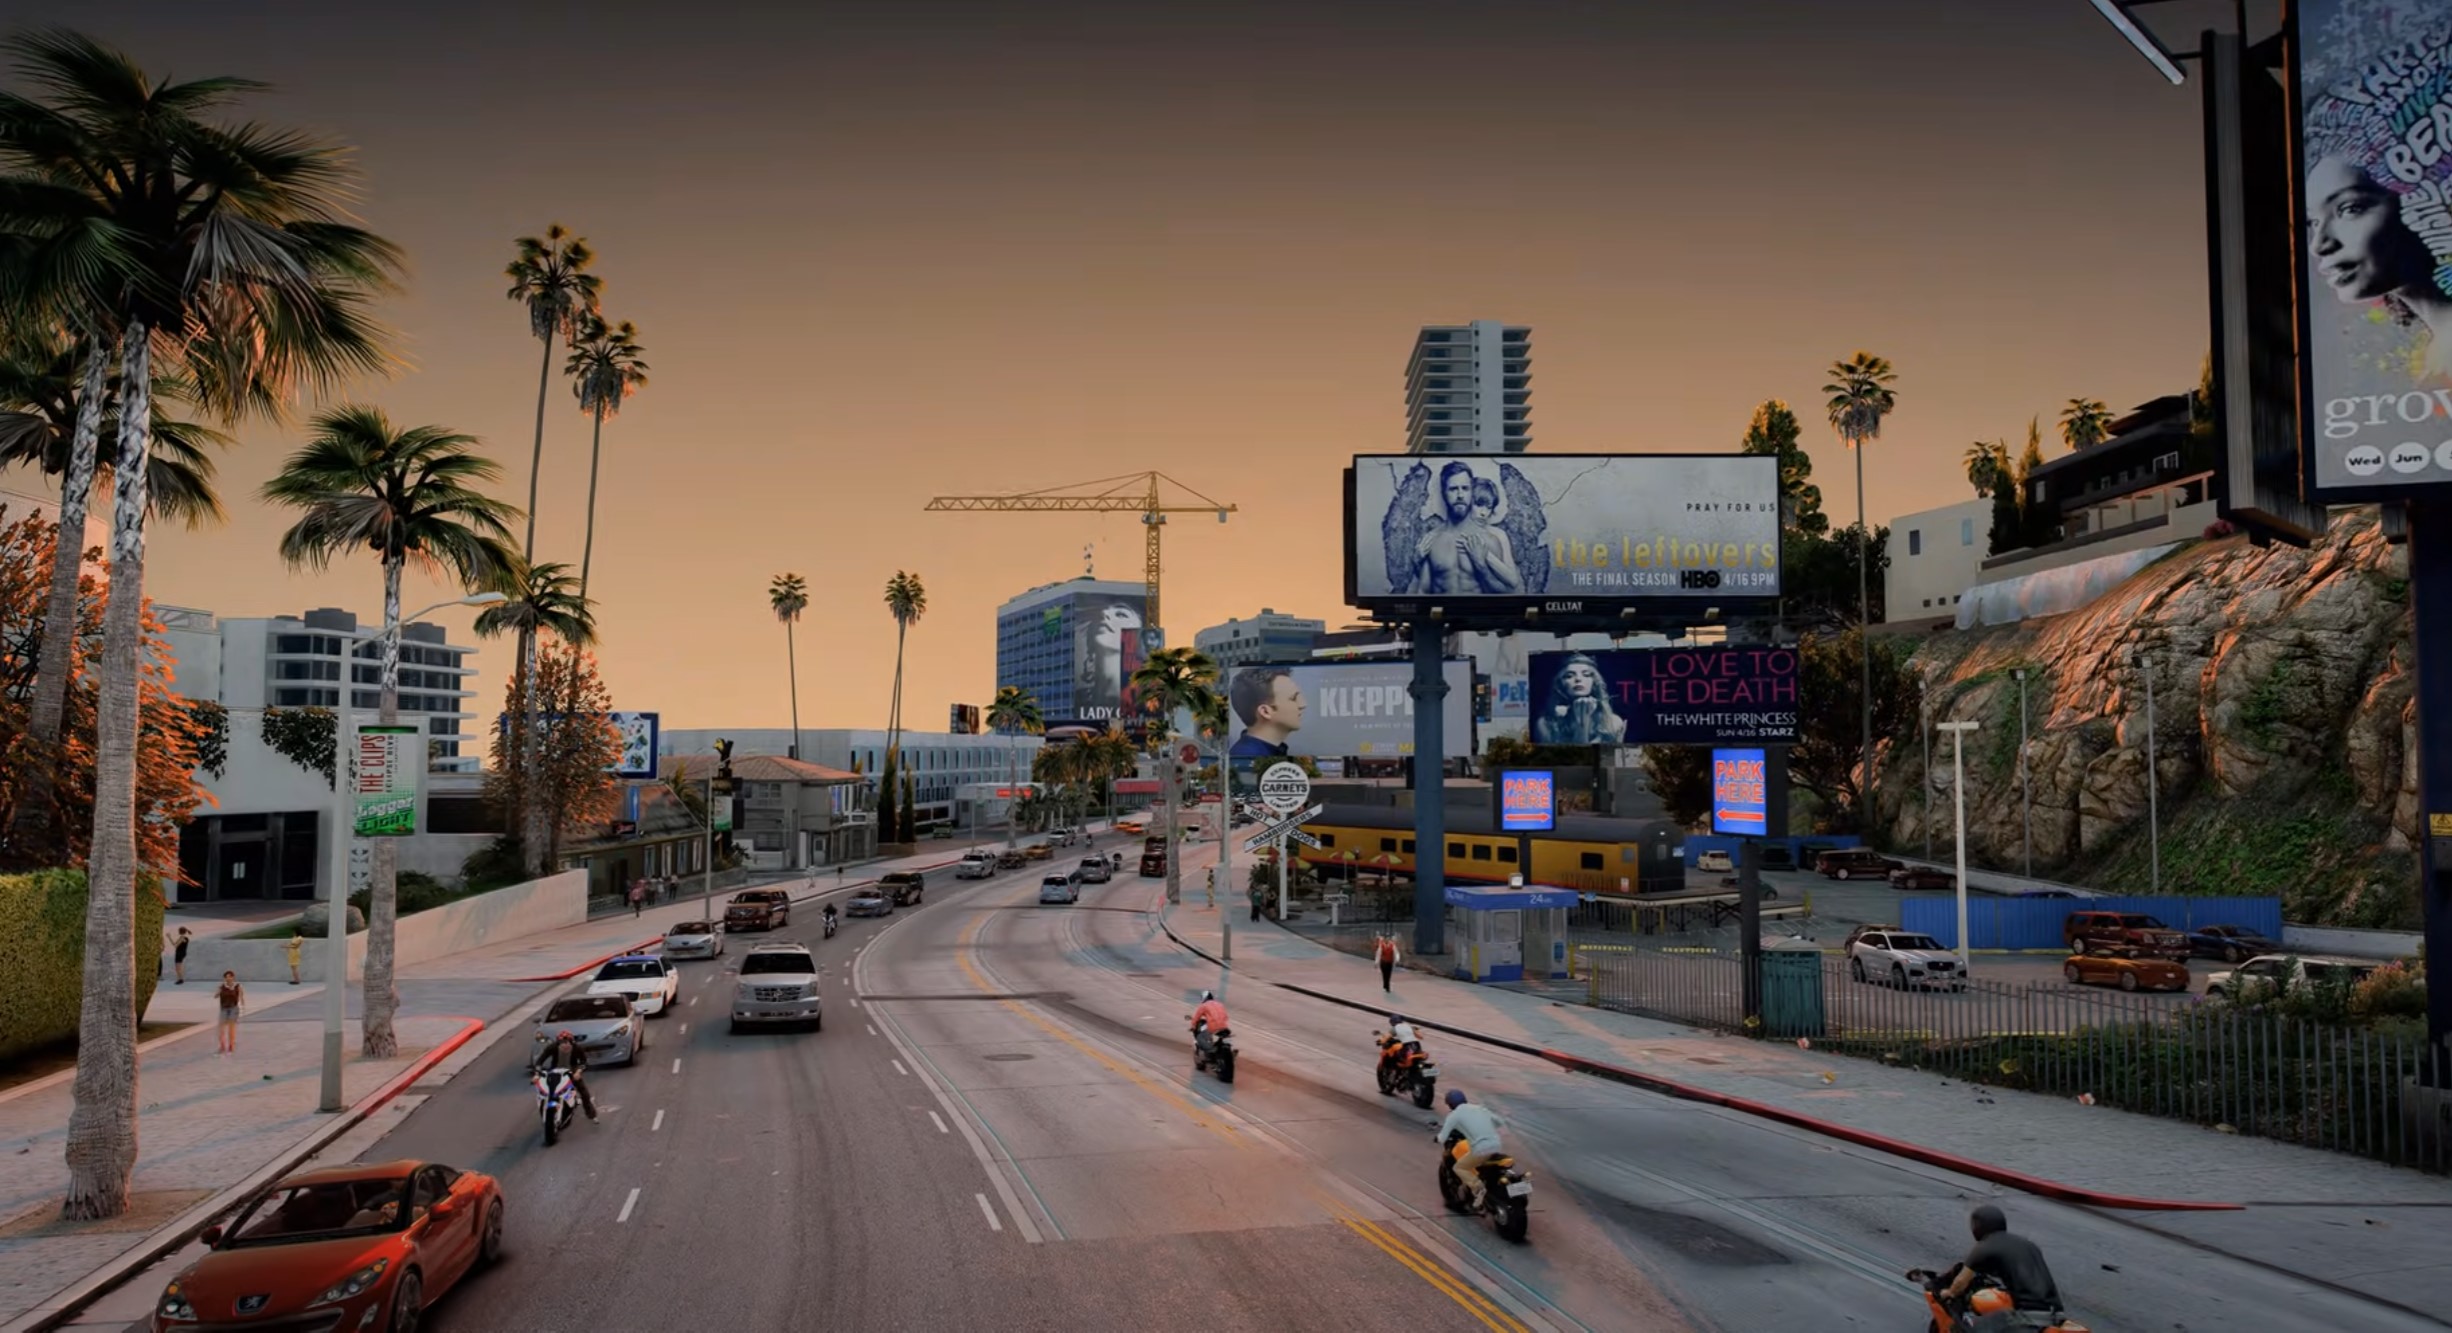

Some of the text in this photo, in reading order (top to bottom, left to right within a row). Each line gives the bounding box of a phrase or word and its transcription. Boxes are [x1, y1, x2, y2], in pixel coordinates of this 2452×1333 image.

[2348, 453, 2423, 467] Wed Jun
[1687, 503, 1776, 512] PRAY FOR US
[1554, 535, 1777, 569] the leftovers
[1572, 570, 1776, 589] THE FINAL SEASON HBO 4/16 9PM
[1651, 650, 1796, 678] LOVE TO
[1616, 676, 1797, 704] THE DEATH
[1080, 706, 1112, 720] LADY
[1734, 712, 1797, 728] PRINCESS
[1716, 727, 1795, 737] SUN 4/16 STARZ
[1714, 760, 1765, 782] PARK
[360, 773, 384, 793] THE
[1503, 778, 1551, 793] PARK
[1503, 795, 1551, 809] HERE
[1714, 782, 1765, 804] HERE
[1249, 808, 1317, 847] HOT DOGS
[1251, 810, 1314, 846] HAMBURGERS
[1529, 893, 1544, 905] 24
